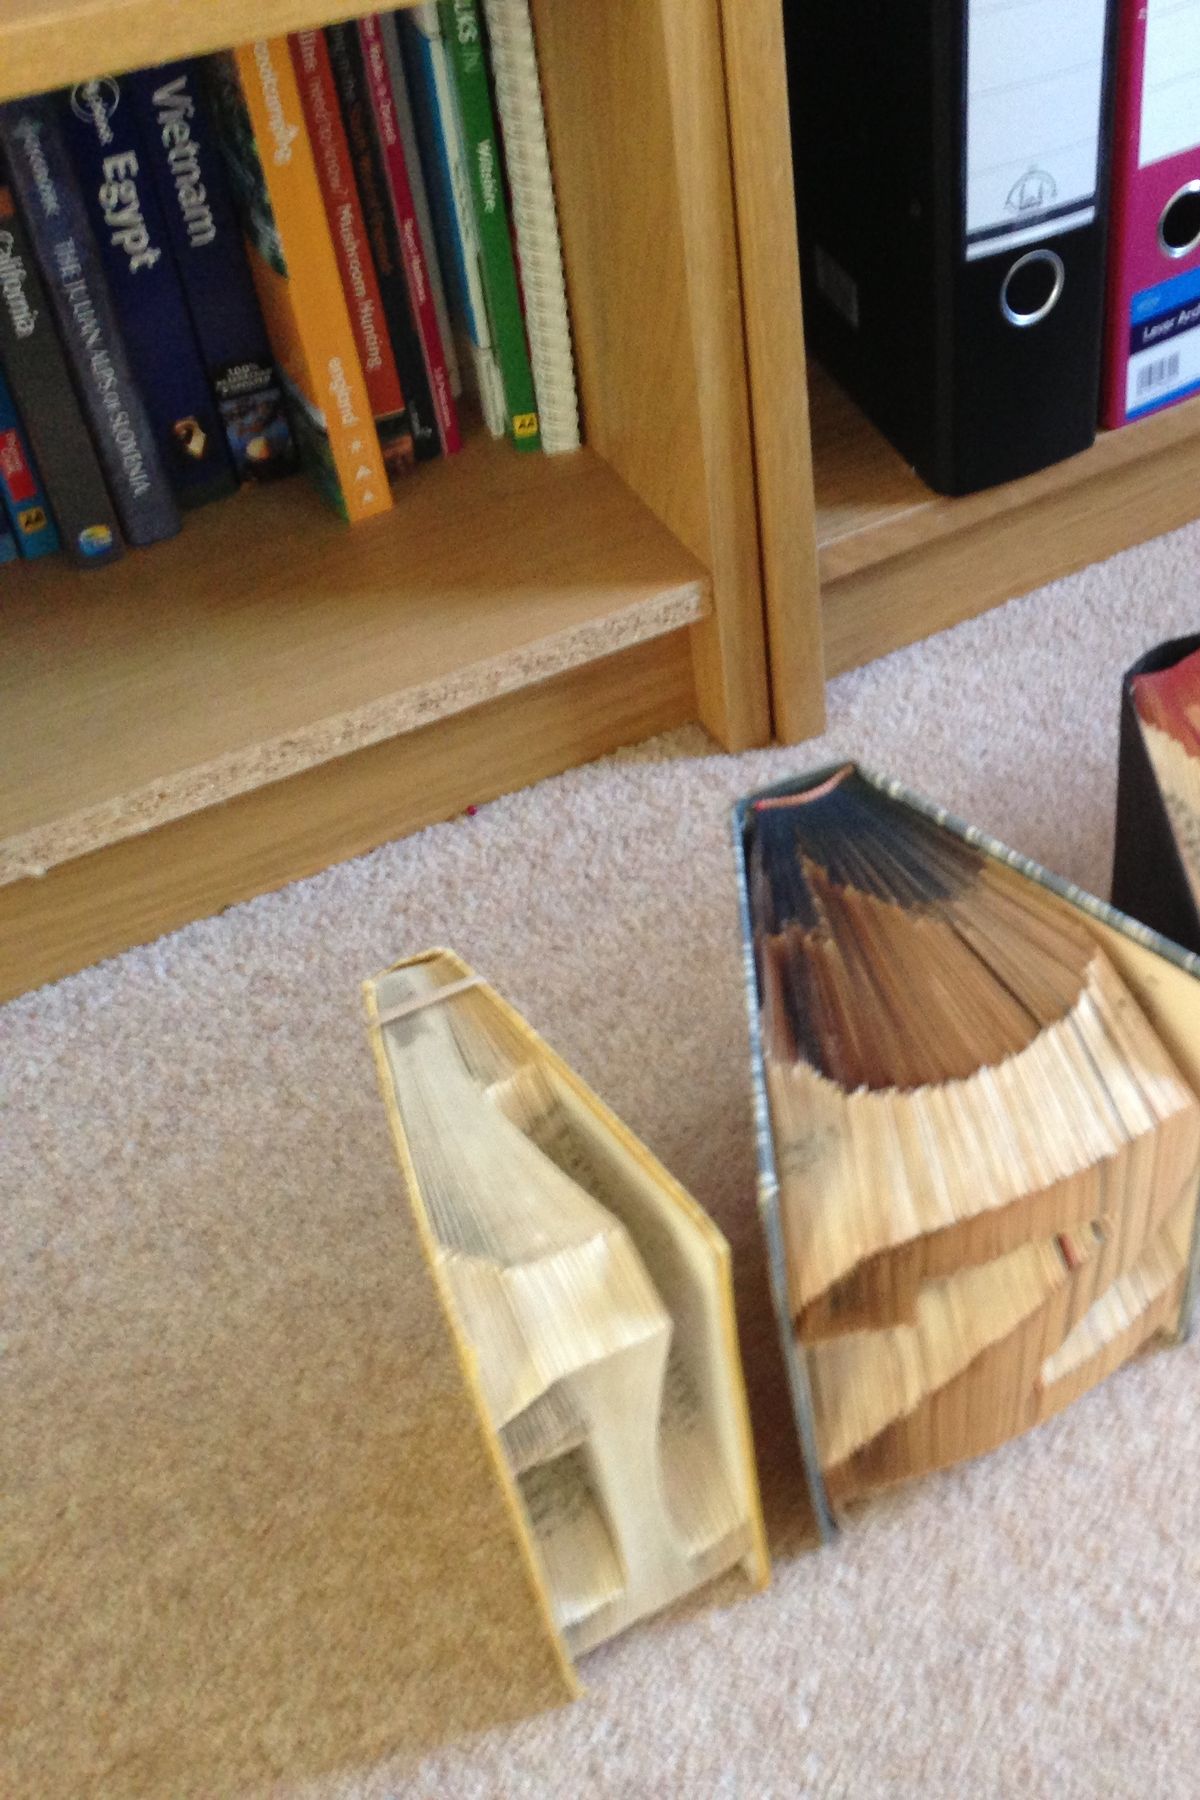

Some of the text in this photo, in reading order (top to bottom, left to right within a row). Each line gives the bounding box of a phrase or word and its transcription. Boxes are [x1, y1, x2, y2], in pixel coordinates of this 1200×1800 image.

[152, 75, 217, 247] Vietnam
[54, 237, 82, 280] THE
[99, 150, 161, 275] Egypt
[0, 231, 39, 339] California
[64, 278, 102, 349] JULIAN
[338, 203, 366, 298] Mushroom
[358, 299, 382, 370] Hunting
[91, 349, 118, 393] ALPS
[111, 410, 151, 498] SLOVENIA
